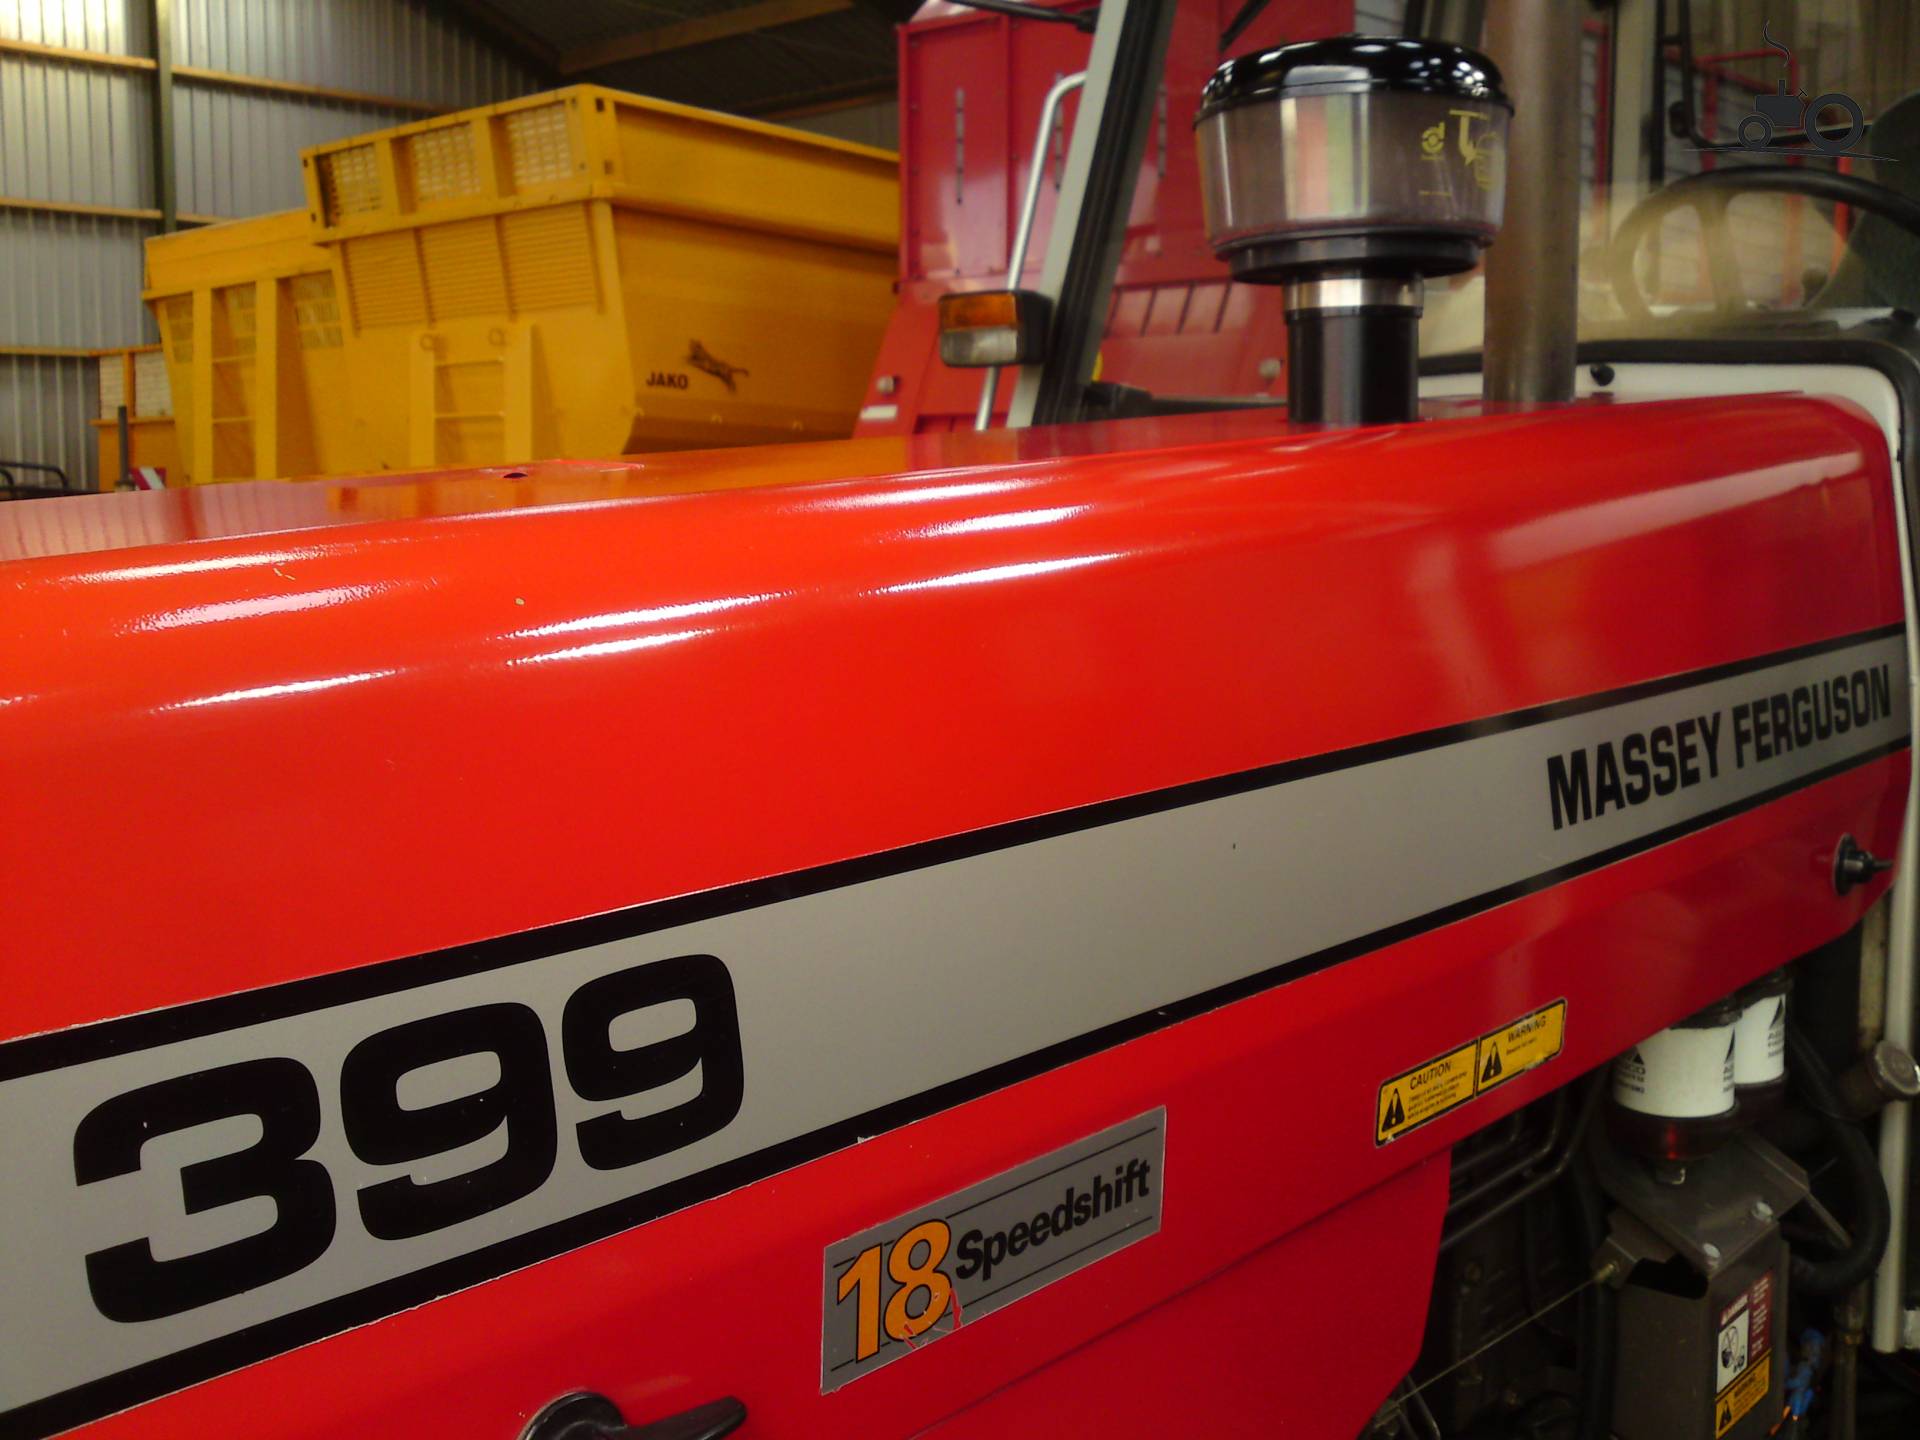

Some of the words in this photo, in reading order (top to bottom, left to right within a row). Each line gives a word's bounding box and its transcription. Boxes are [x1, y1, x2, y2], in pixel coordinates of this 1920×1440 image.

[646, 371, 689, 389] JAKO
[1547, 711, 1721, 831] MASSEY
[1732, 664, 1892, 769] FERGUSON
[1410, 1061, 1452, 1090] CAUTION
[1507, 1015, 1547, 1043] WARNING
[73, 953, 745, 1324] 399
[837, 1218, 952, 1364] 18
[955, 1158, 1150, 1281] Speedshift
